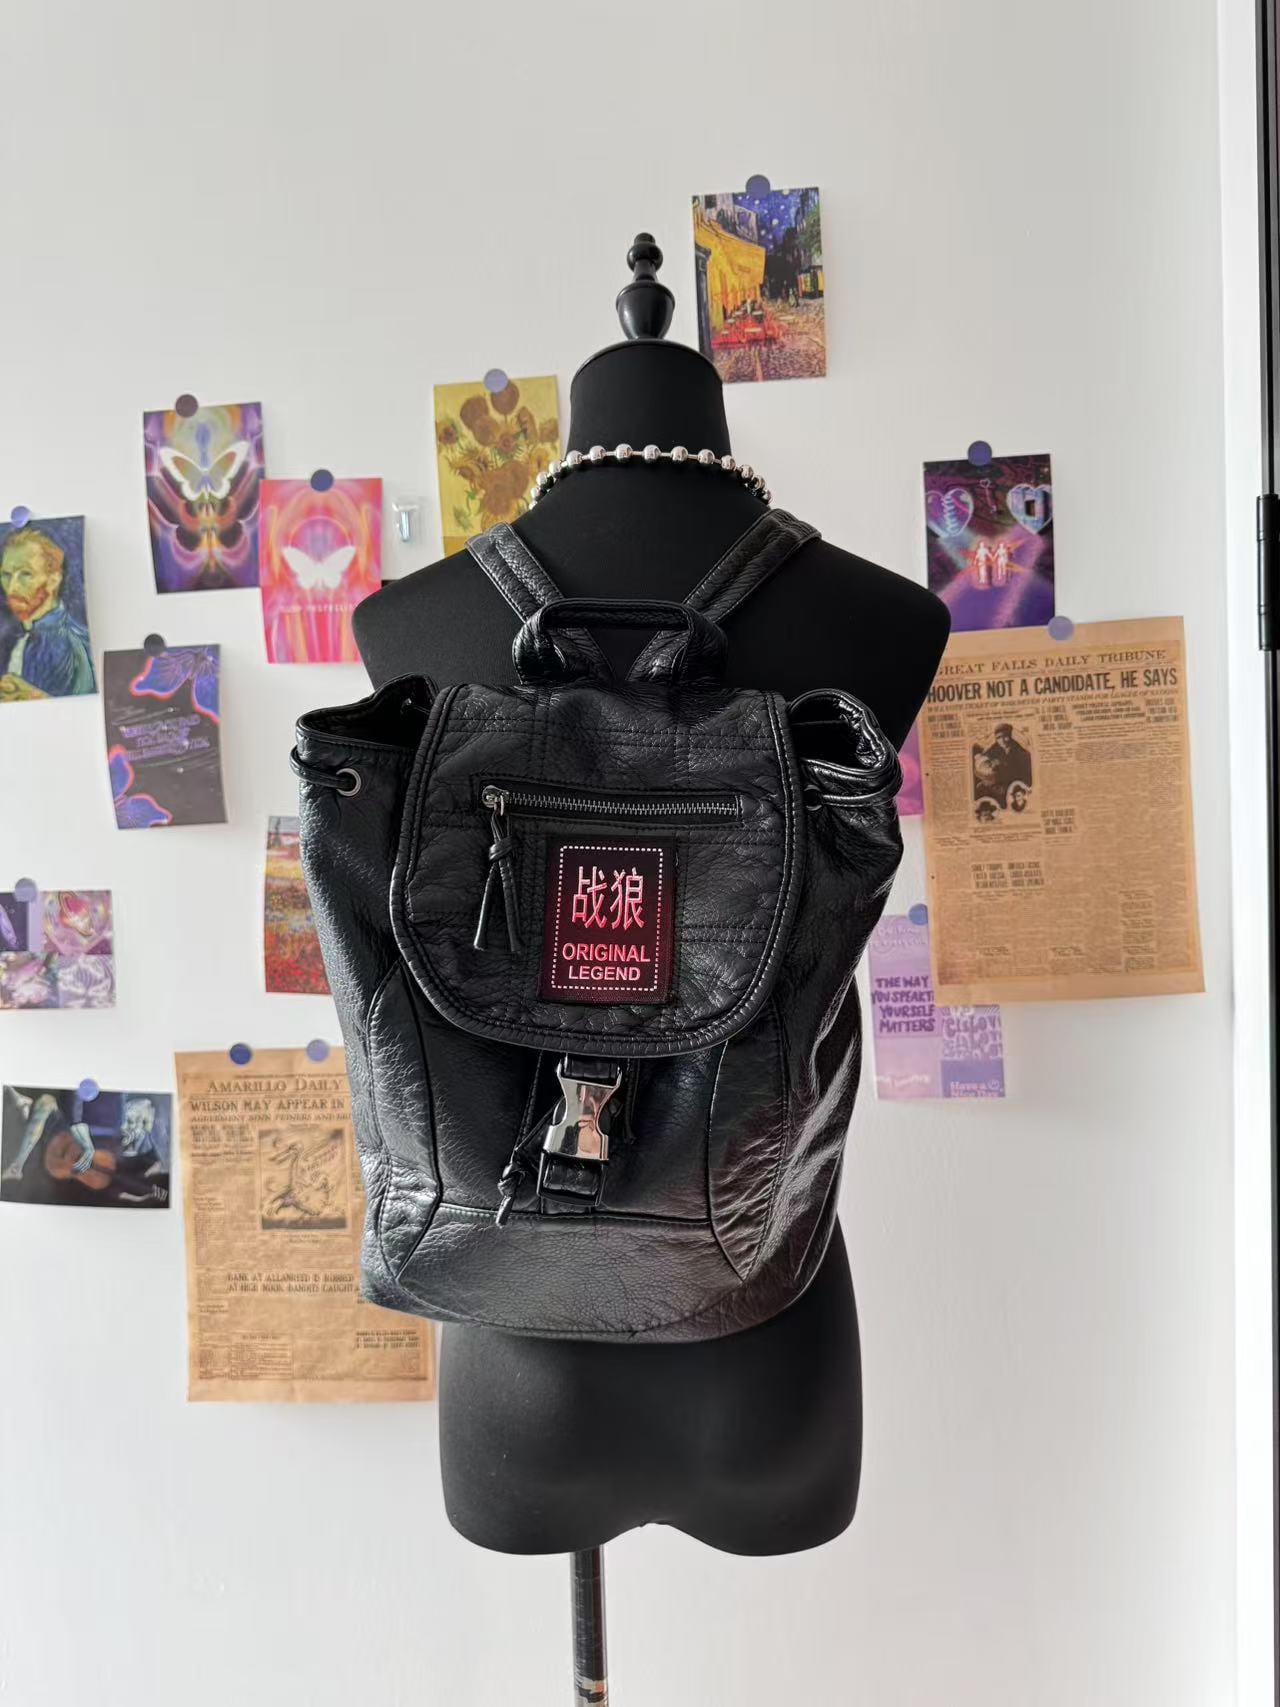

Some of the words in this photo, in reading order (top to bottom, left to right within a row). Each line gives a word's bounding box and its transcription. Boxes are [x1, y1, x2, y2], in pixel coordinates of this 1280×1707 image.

[940, 663, 985, 675] REAT
[992, 658, 1038, 671] FALLS
[1045, 654, 1090, 667] DAILY
[1097, 649, 1167, 663] TRIBUNE
[928, 682, 982, 703] HOOVER
[987, 680, 1015, 699] NOT
[1020, 678, 1029, 696] A
[1034, 672, 1116, 695] CANDIDATE,
[1120, 670, 1138, 688] HE
[1143, 667, 1178, 686] SAYS
[572, 866, 645, 930] 战狼
[562, 943, 651, 962] ORIGINAL
[568, 965, 641, 981] LEGEND
[875, 977, 901, 988] THE
[902, 975, 929, 988] WAY
[871, 990, 890, 1004] YOU
[891, 990, 926, 1002] SPEAK
[879, 1004, 935, 1018] YOURSELF
[879, 1018, 936, 1032] MATTERS
[208, 1080, 287, 1093] AMARILLO
[295, 1078, 343, 1091] DAILY
[190, 1101, 238, 1112] WILSON
[244, 1100, 272, 1111] MAY
[277, 1100, 328, 1111] APPEAR
[331, 1099, 344, 1109] IN
